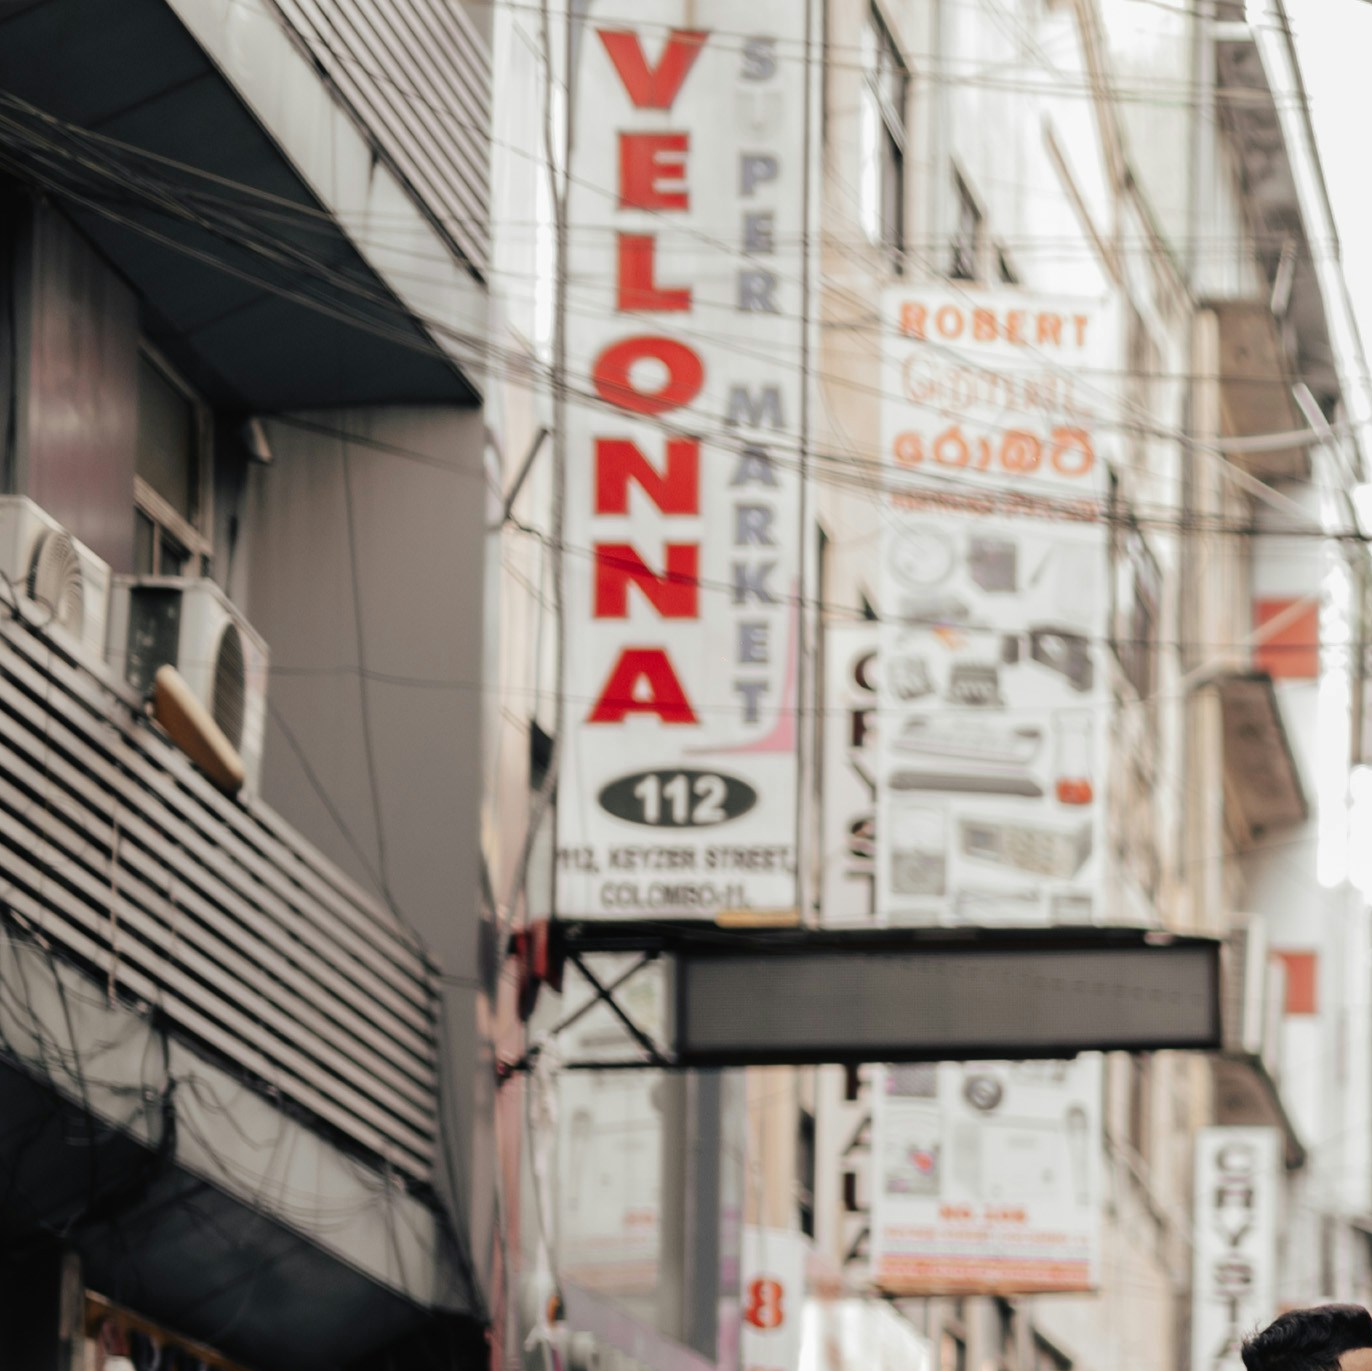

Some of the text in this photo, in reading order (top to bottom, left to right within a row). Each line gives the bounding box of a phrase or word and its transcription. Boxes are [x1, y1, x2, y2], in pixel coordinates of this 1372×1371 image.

[588, 28, 710, 725] VELONNA
[727, 36, 785, 724] SUPER MARKET
[899, 301, 1089, 348] ROBERT
[634, 773, 730, 825] 112
